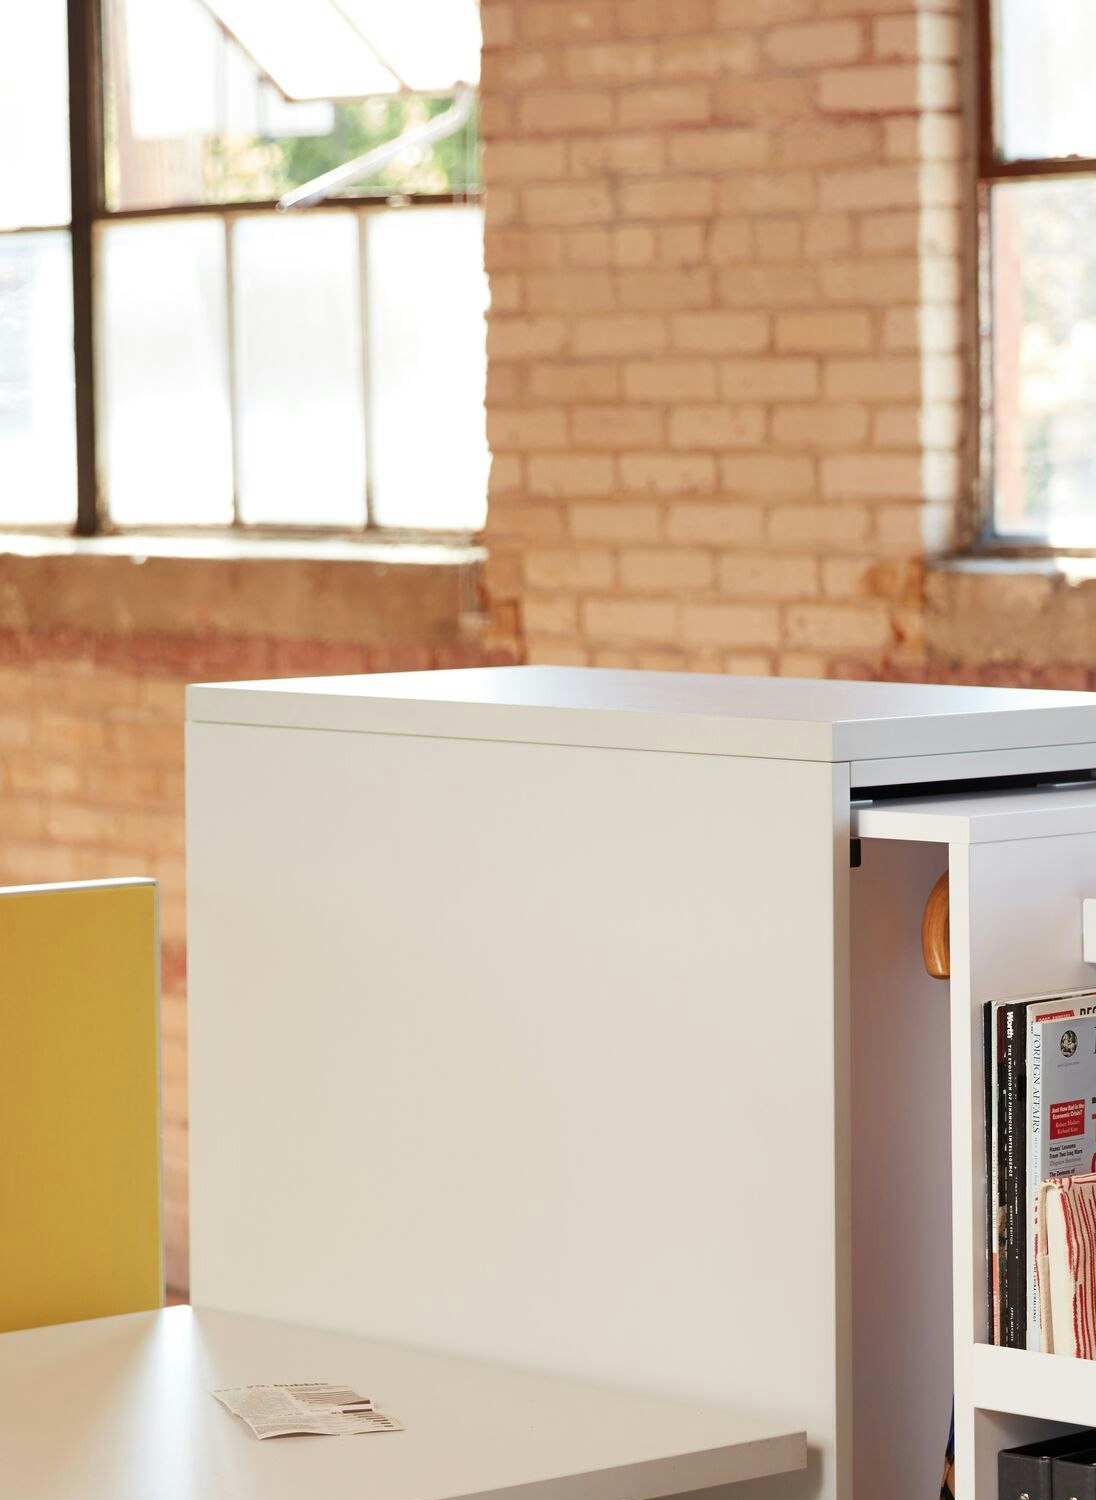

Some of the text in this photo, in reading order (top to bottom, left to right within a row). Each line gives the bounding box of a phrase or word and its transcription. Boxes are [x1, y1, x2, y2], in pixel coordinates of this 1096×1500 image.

[1006, 1012, 1014, 1038] Worth
[1033, 1033, 1041, 1133] FOREIGN AFFAIRS
[1053, 1112, 1070, 1120] Economic
